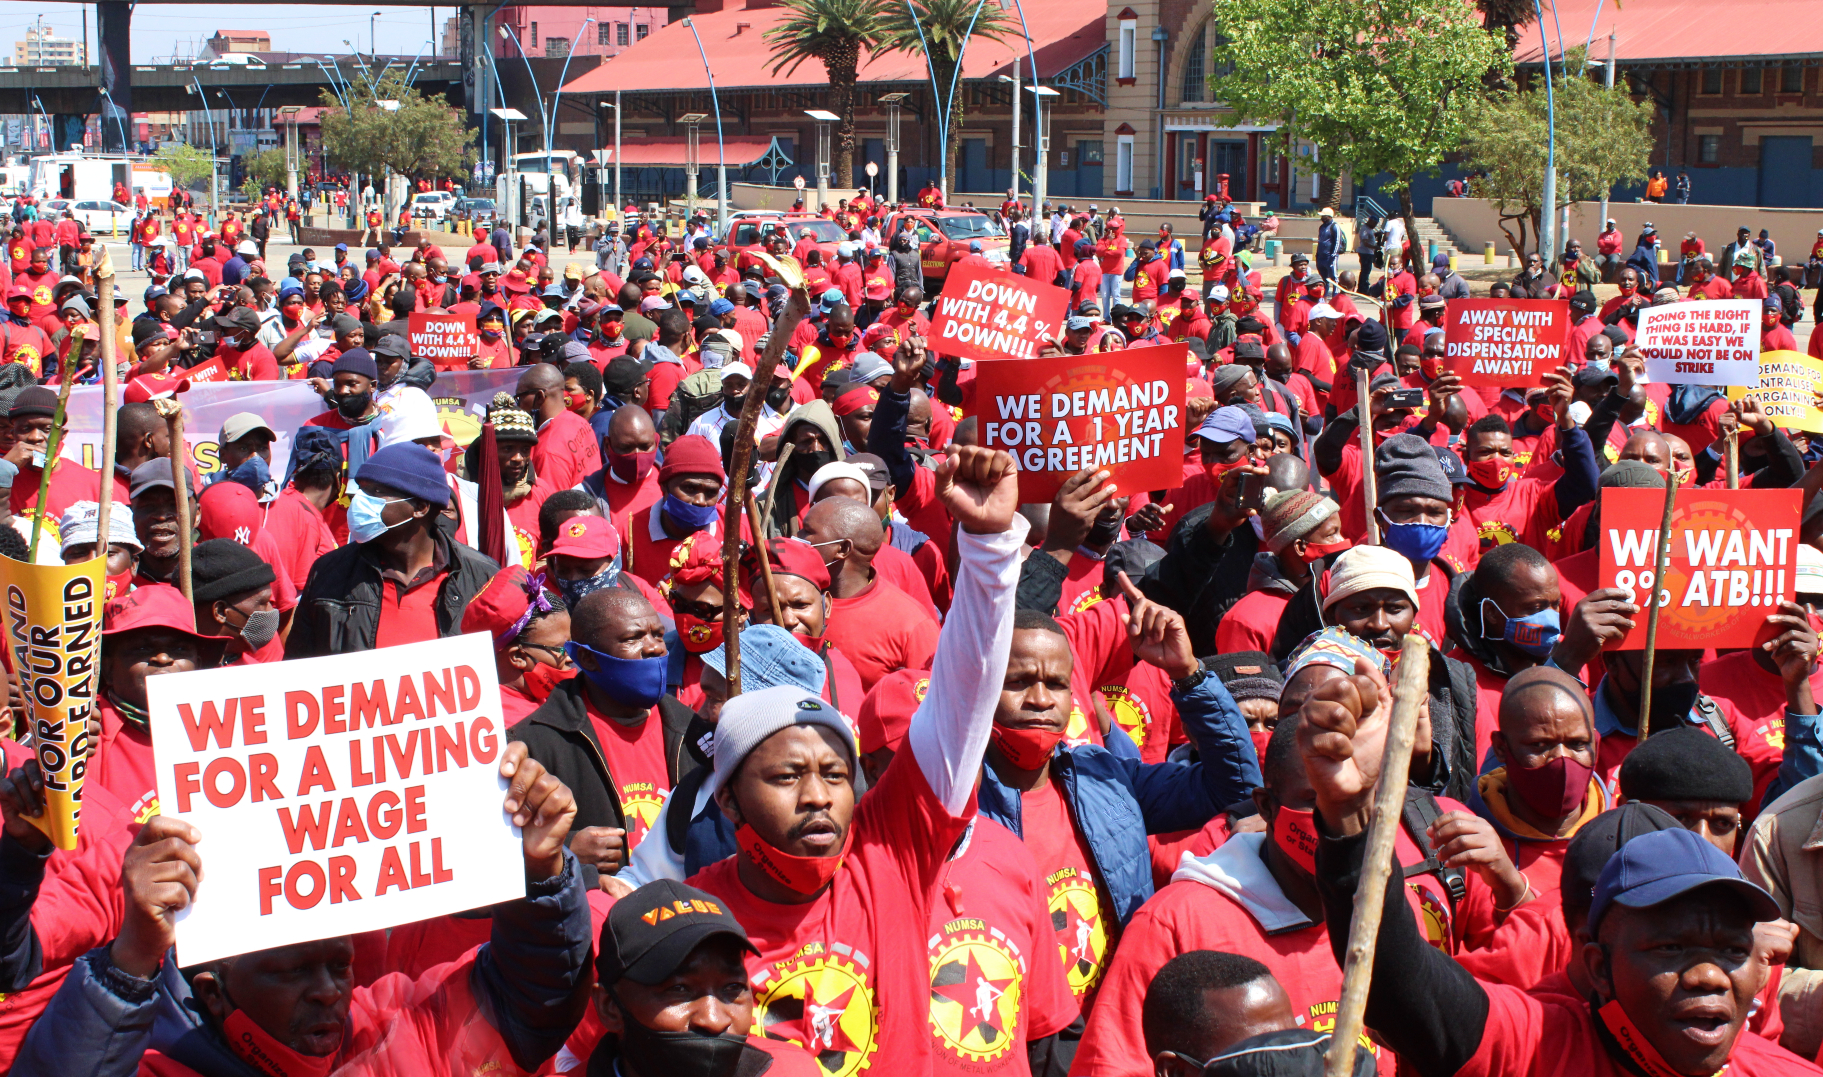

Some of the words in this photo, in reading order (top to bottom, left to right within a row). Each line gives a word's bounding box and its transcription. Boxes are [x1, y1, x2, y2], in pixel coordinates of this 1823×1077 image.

[922, 260, 945, 268] ELECTIONS
[967, 279, 1037, 314] DOWN
[941, 297, 991, 324] WITH
[993, 309, 1028, 335] 4.4
[1034, 320, 1051, 343] %
[1459, 310, 1507, 325] AWAY
[1511, 311, 1553, 326] WITH
[1648, 310, 1686, 325] DOING
[1690, 310, 1711, 321] THE
[1714, 310, 1750, 321] RIGHT
[425, 321, 466, 334] DOWN
[1473, 326, 1536, 343] SPECIAL
[1645, 323, 1681, 335] THING
[1685, 323, 1695, 333] IS
[1699, 322, 1736, 334] HARD,
[1740, 323, 1750, 334] IF
[411, 333, 443, 345] WITH
[446, 334, 465, 345] 4.4
[466, 333, 476, 345] %
[942, 319, 1034, 360] DOWN!!!
[1648, 336, 1658, 346] IT
[1661, 336, 1688, 346] WAS
[1692, 335, 1722, 347] EASY
[1725, 336, 1744, 347] WE
[418, 345, 471, 358] DOWN!!!
[1447, 342, 1560, 359] DISPENSATION
[1639, 348, 1682, 359] WOULD
[1686, 350, 1712, 360] NOT
[1715, 350, 1729, 361] BE
[1732, 350, 1753, 361] ON
[194, 364, 218, 381] WITH
[1472, 359, 1532, 375] AWAY!!
[1675, 361, 1714, 374] STRIKE
[1807, 368, 1822, 383] FOR
[1746, 377, 1815, 393] NTRALISED
[995, 394, 1042, 420] WE
[1051, 379, 1170, 418] DEMAND
[1764, 405, 1806, 419] ONLY!!!
[986, 421, 1043, 446] FOR
[1051, 420, 1073, 445] A
[1092, 416, 1102, 441] 1
[1114, 404, 1180, 437] YEAR
[1011, 432, 1165, 472] AGREEMENT
[1608, 529, 1672, 567] WE
[1684, 528, 1793, 567] WANT
[1615, 569, 1671, 608] 8%
[1681, 568, 1786, 608] ATB!!!
[31, 624, 65, 708] OUR
[1101, 685, 1128, 694] NUMSA
[177, 694, 267, 752] WE
[284, 664, 481, 740] DEMAND
[37, 718, 69, 792] FOR
[173, 752, 284, 813] FOR
[296, 745, 336, 796] A
[349, 716, 498, 788] LIVING
[623, 783, 653, 794] NUMSA
[276, 784, 428, 854] WAGE
[1289, 822, 1320, 844] Organ
[1286, 835, 1297, 844] or
[1297, 841, 1315, 857] Sta
[753, 842, 792, 885] Organize
[258, 854, 362, 916] FOR
[375, 837, 453, 896] ALL
[1046, 867, 1077, 885] NUMSA
[641, 898, 722, 926] VALUE
[944, 919, 985, 936] NUMSA
[1310, 1001, 1338, 1018] NUM
[931, 1040, 947, 1060] NION
[949, 1057, 958, 1068] OF
[960, 1062, 985, 1074] METAL
